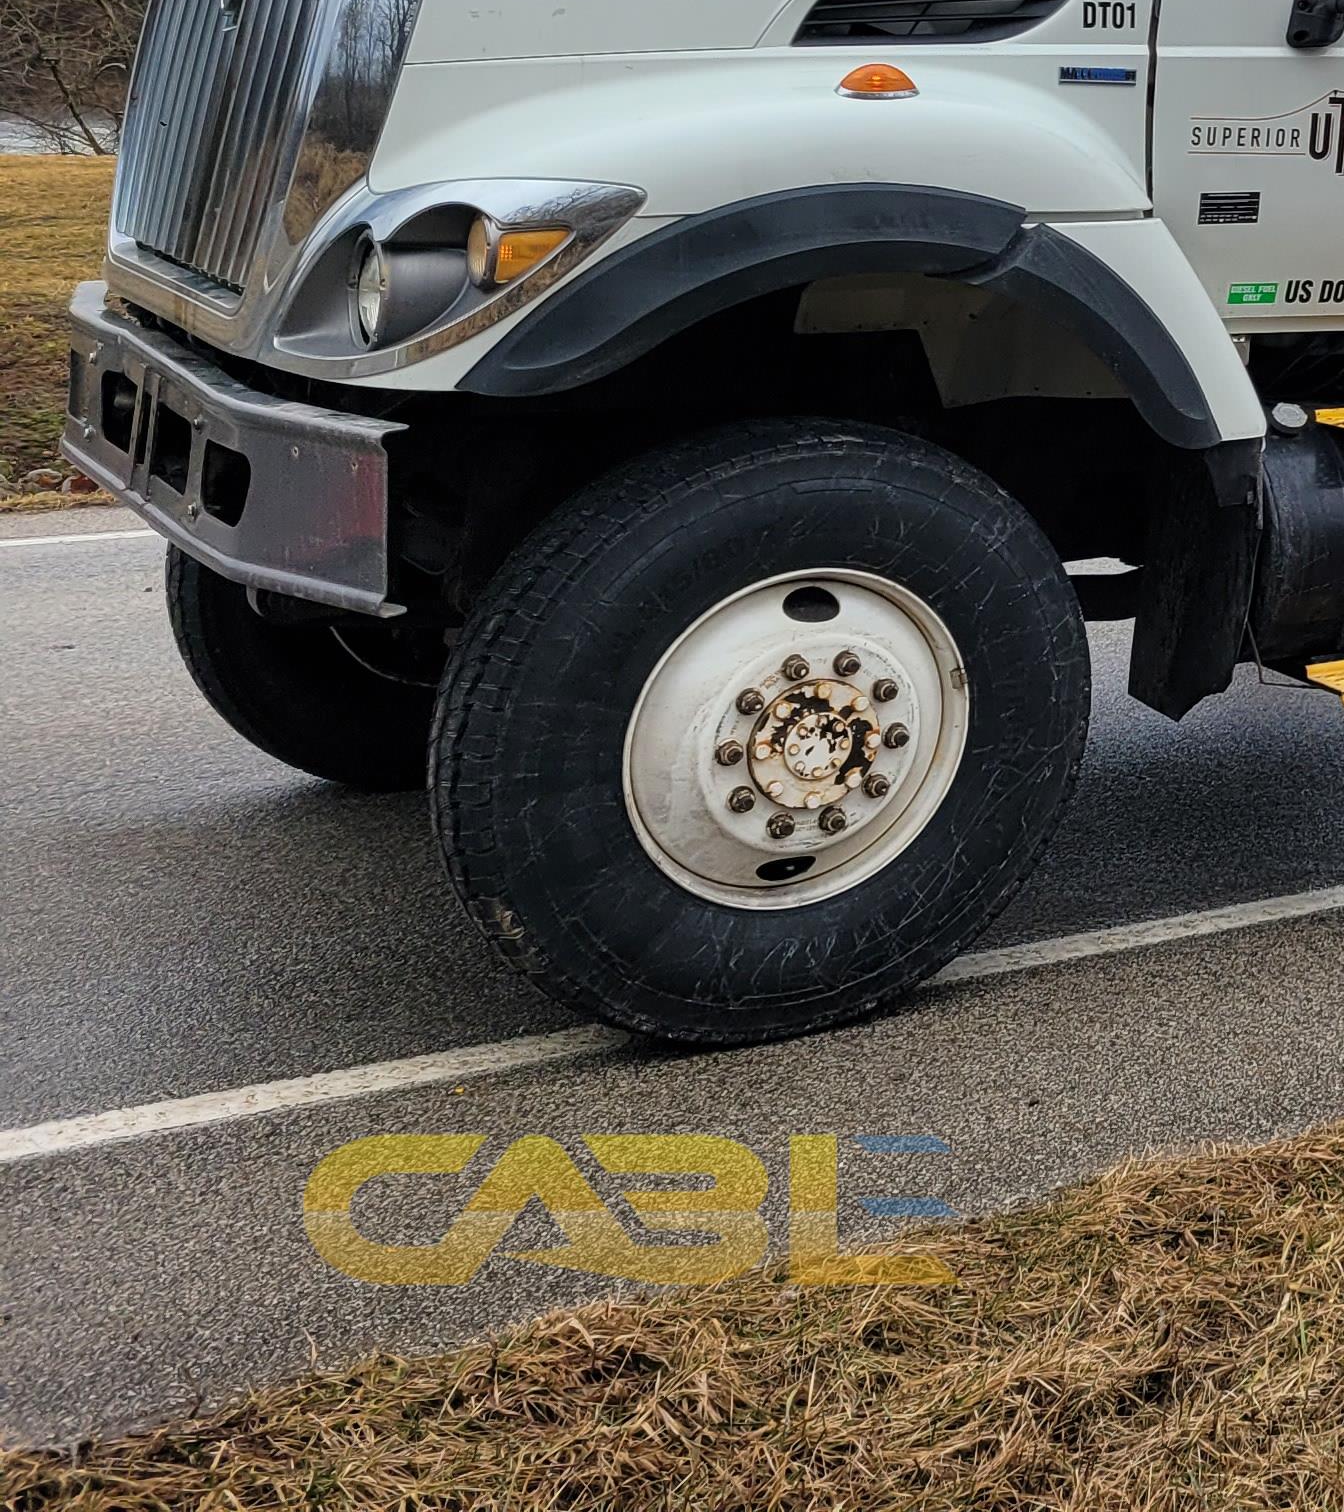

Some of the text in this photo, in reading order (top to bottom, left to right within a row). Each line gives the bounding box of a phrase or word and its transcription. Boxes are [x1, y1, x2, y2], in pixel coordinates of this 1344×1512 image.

[1082, 1, 1136, 29] DT01
[1190, 126, 1301, 148] SUPERIOR
[1284, 279, 1313, 303] US
